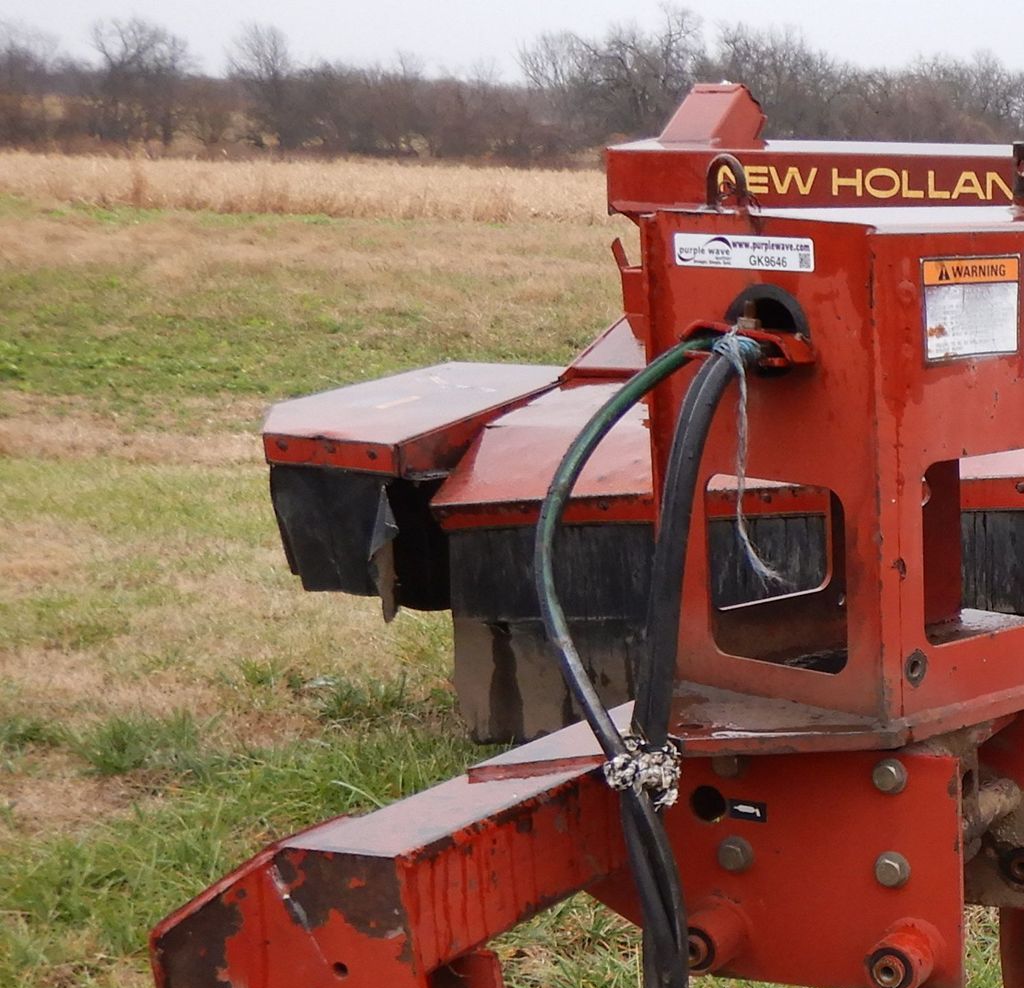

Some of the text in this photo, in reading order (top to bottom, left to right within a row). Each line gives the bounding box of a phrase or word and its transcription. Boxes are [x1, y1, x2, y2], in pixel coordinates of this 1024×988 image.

[717, 165, 1014, 200] NEW HOLLAN
[679, 246, 730, 257] purple wave
[732, 240, 810, 252] www.purplewave.com
[749, 254, 787, 268] GK9646
[951, 264, 1006, 278] WARNING
